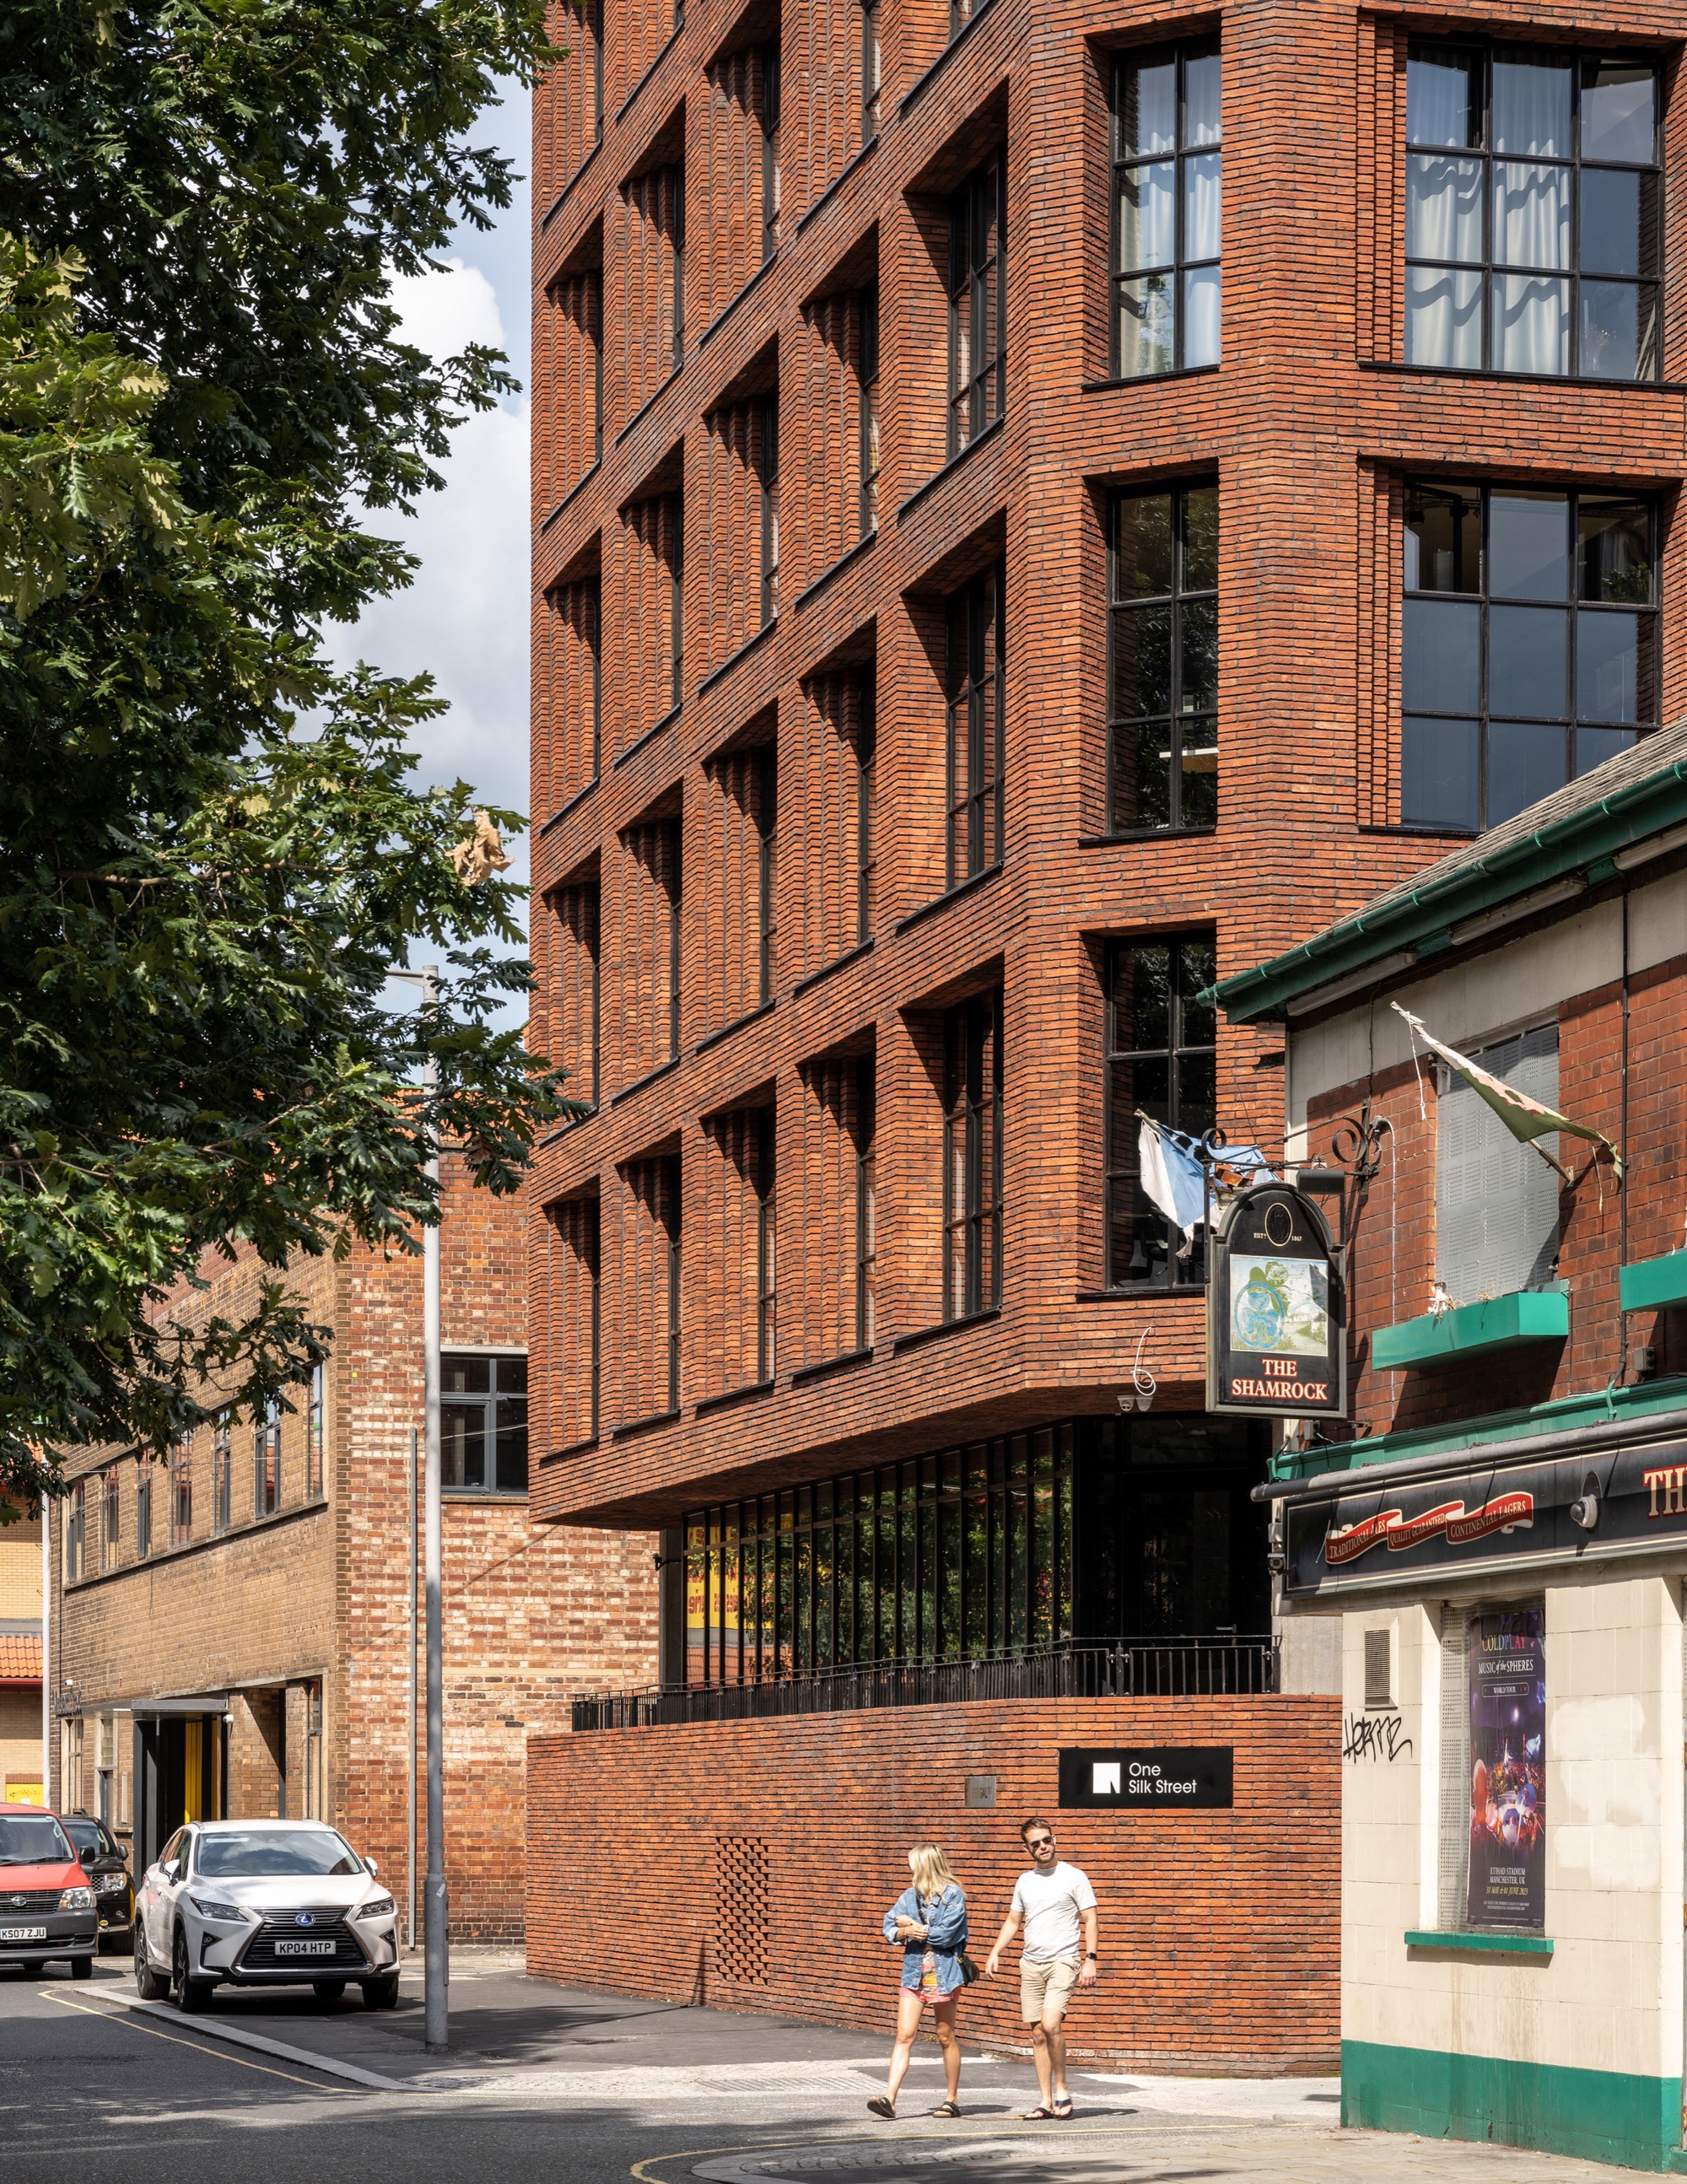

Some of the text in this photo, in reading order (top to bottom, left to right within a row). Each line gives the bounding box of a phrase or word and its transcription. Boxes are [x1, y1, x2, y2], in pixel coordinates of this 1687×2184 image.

[1262, 1359, 1298, 1377] THE
[1232, 1378, 1328, 1400] SHAMROCK
[1643, 1464, 1687, 1518] TH
[1451, 1501, 1526, 1538] CONTINENTAL LAGERS
[1390, 1513, 1444, 1546] QUALITY GUARANTEED
[1329, 1520, 1385, 1558] TRADITIONAL ALES
[1482, 1633, 1526, 1651] COLDPLAY
[1478, 1662, 1496, 1674] MUSIC
[1496, 1660, 1501, 1674] of
[1506, 1659, 1533, 1672] SPHERES
[1129, 1762, 1161, 1777] One
[1129, 1779, 1197, 1793] Silk Street
[1506, 1867, 1525, 1875] STADIUM
[1490, 1876, 1518, 1885] MANCHESTER,
[1508, 1887, 1518, 1895] JUNE
[2, 1928, 45, 1939] KS07 ZJU
[280, 1943, 331, 1954] KP04 HTP
